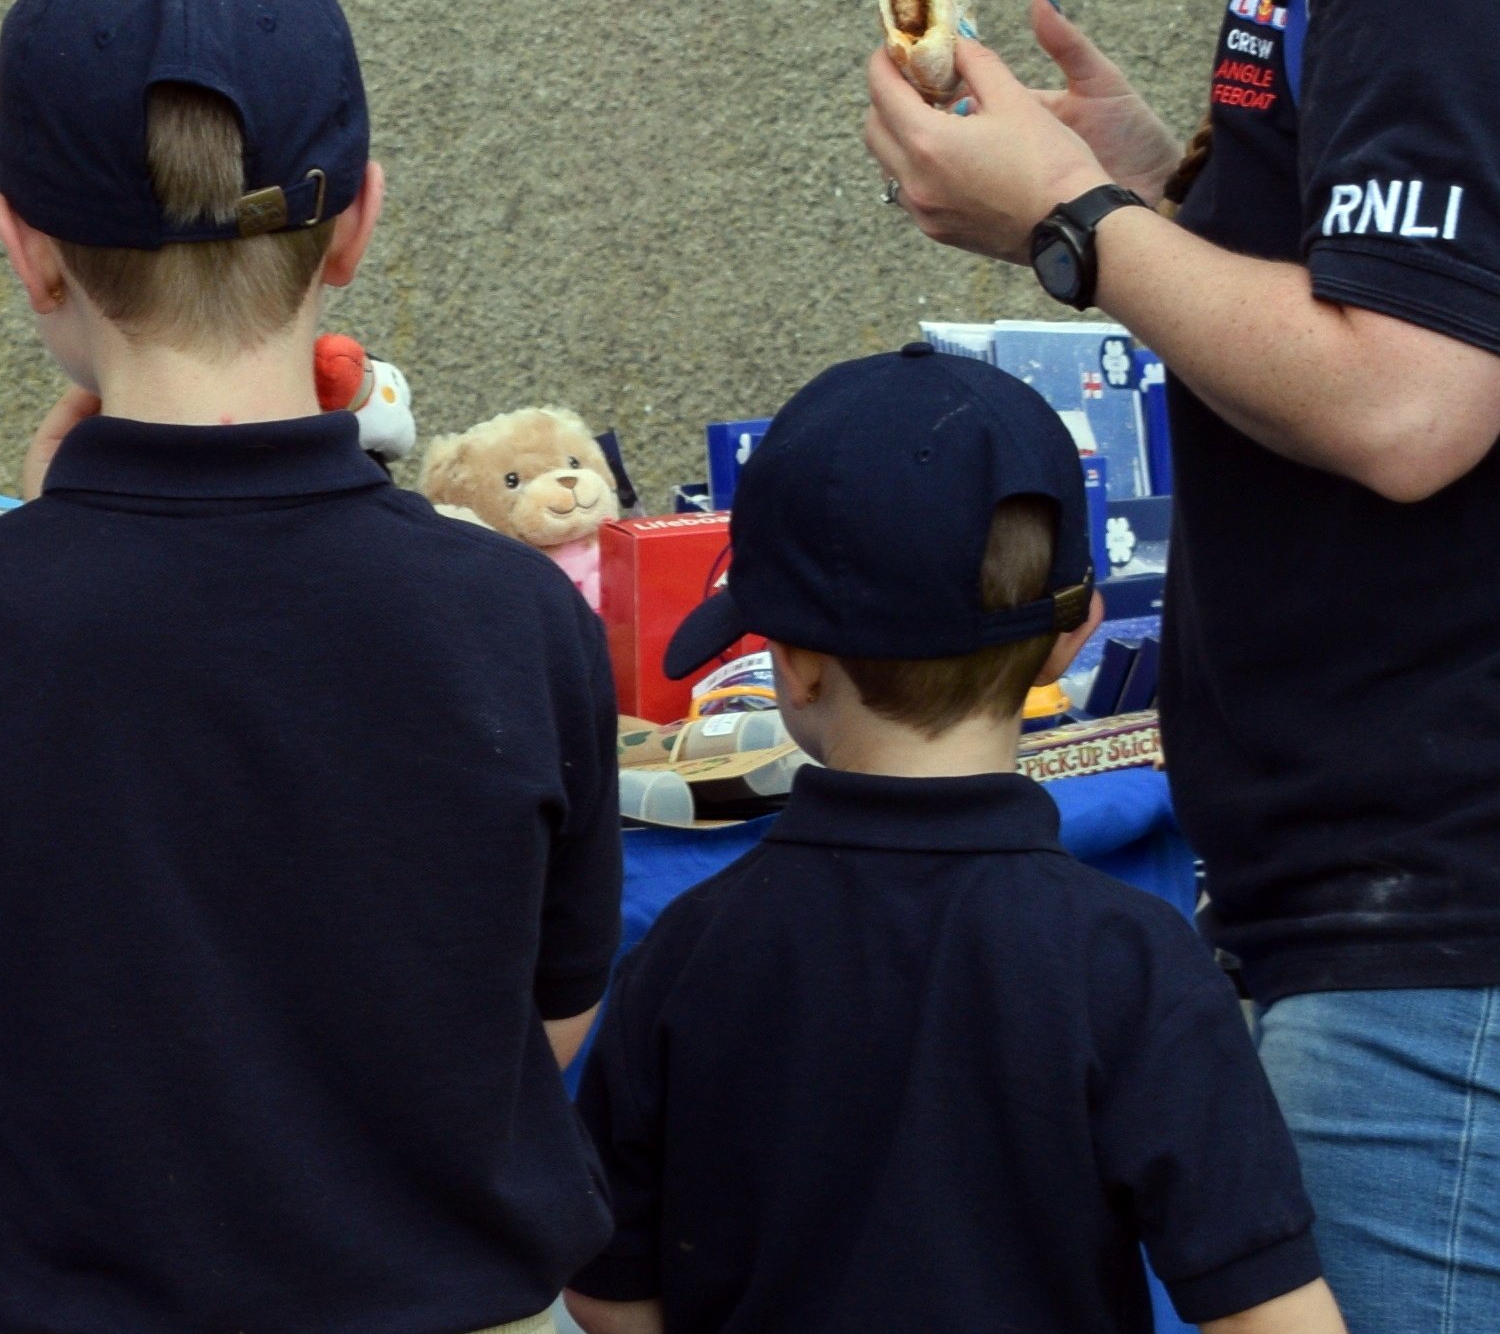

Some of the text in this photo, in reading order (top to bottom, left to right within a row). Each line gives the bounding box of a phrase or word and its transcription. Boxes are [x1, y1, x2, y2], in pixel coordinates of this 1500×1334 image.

[1227, 28, 1274, 59] CREW
[1216, 59, 1275, 88] ANGLE
[1212, 83, 1278, 111] FEBOAT
[1322, 179, 1463, 240] RNLI
[633, 515, 732, 530] Lifeboa
